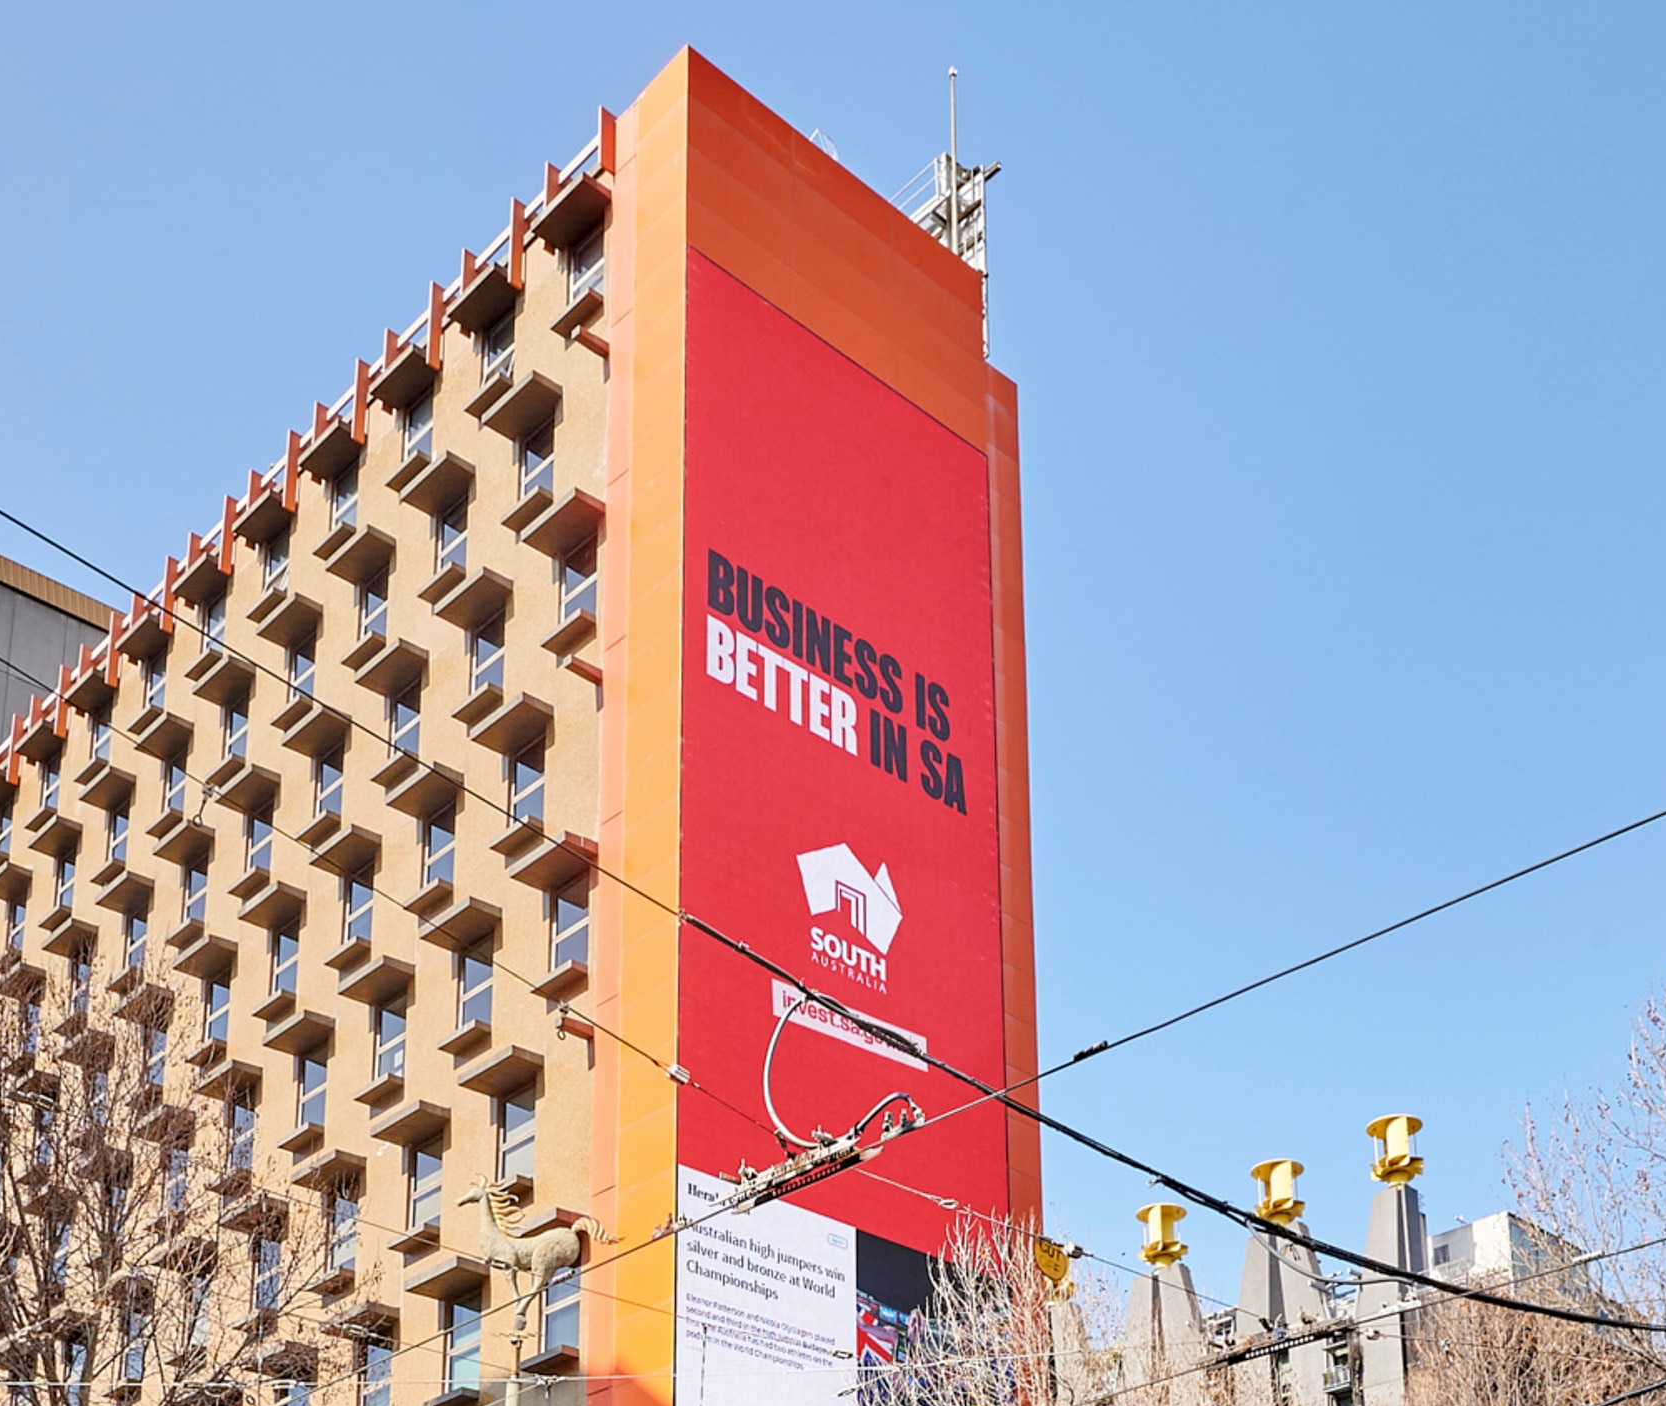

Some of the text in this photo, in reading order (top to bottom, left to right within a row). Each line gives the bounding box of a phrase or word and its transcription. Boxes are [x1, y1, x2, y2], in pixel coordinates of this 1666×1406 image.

[708, 548, 950, 742] BUSINESS IS
[706, 613, 967, 816] BETTER IN SA
[810, 926, 886, 981] SOUTH
[811, 951, 887, 994] AUSTRALIA
[686, 1218, 846, 1283] Australian high jumpers win
[686, 1240, 836, 1298] silver and bronze at World
[686, 1259, 779, 1300] Championships
